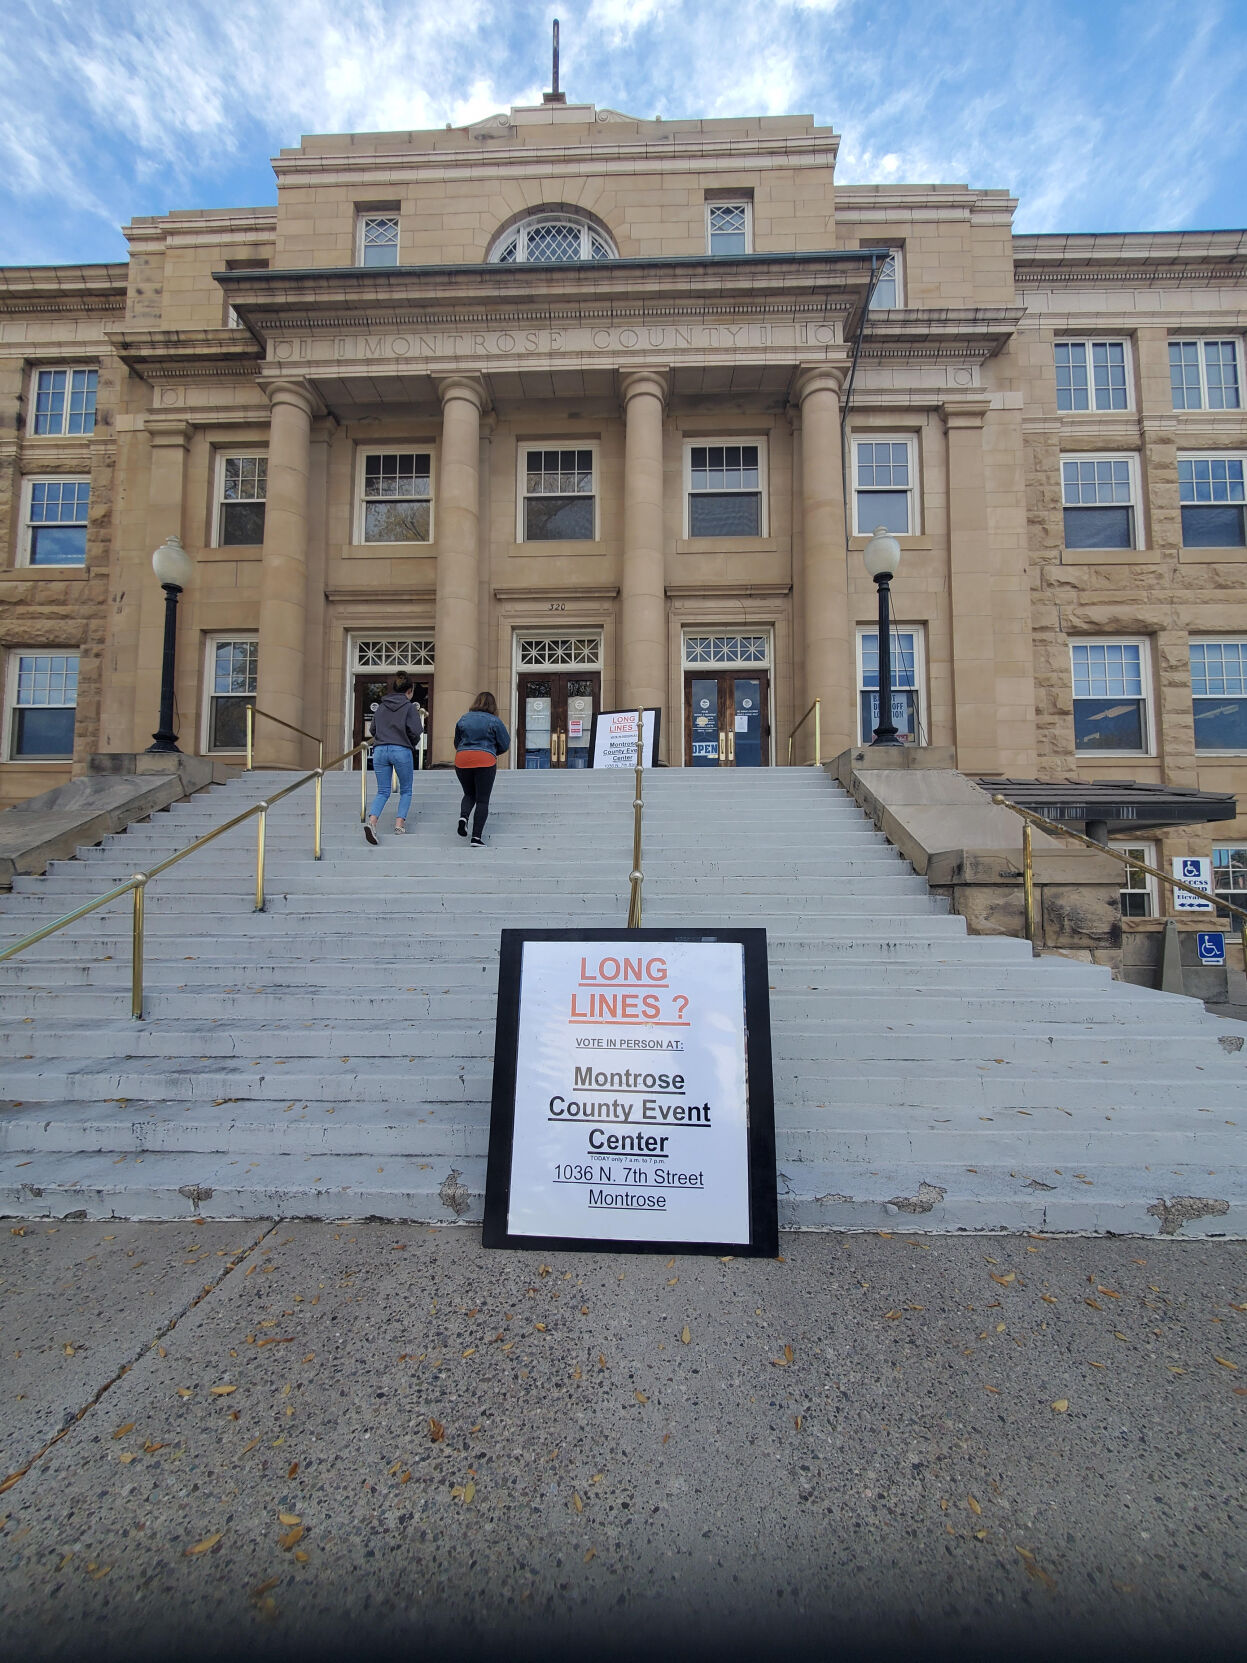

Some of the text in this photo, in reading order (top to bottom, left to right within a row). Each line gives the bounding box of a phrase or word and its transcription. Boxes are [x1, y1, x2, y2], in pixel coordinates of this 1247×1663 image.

[363, 326, 743, 357] MONTROSE COUNTY
[612, 716, 636, 724] LONG
[692, 744, 718, 754] OPEN
[580, 957, 668, 981] LONG
[570, 993, 690, 1019] LINES ?
[575, 1037, 685, 1050] VOTE IN PERSON AT:
[574, 1066, 685, 1090] Montrose
[549, 1096, 711, 1122] County Event
[588, 1128, 669, 1152] Center
[554, 1164, 704, 1186] 1036 N. 7th Street
[589, 1189, 667, 1208] Montrose
